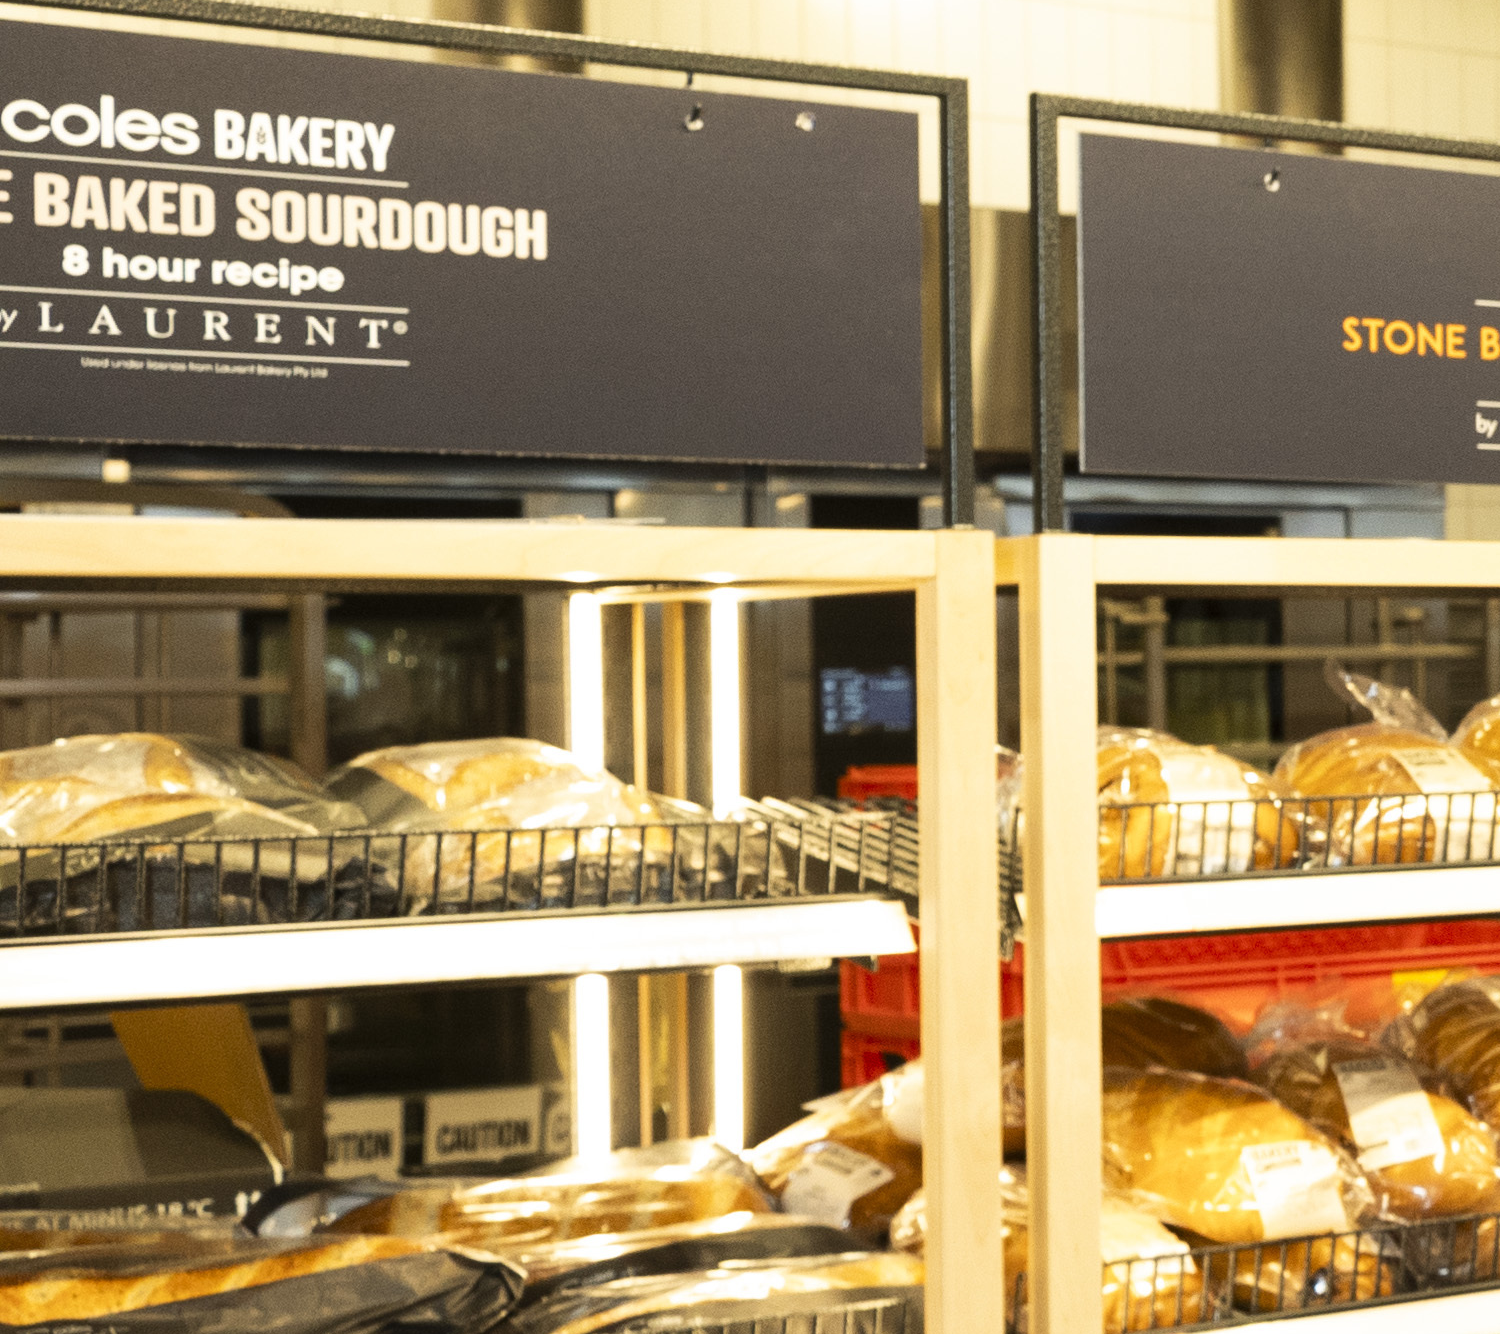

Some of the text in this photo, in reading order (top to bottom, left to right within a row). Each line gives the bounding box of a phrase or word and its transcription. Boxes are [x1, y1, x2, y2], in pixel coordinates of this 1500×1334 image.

[1, 95, 395, 172] coles BAKERY
[34, 172, 215, 236] BAKED
[235, 187, 548, 260] SOURDOUGH
[62, 244, 345, 296] 8 hour recipe
[1342, 316, 1467, 359] STONE
[1475, 412, 1498, 438] by
